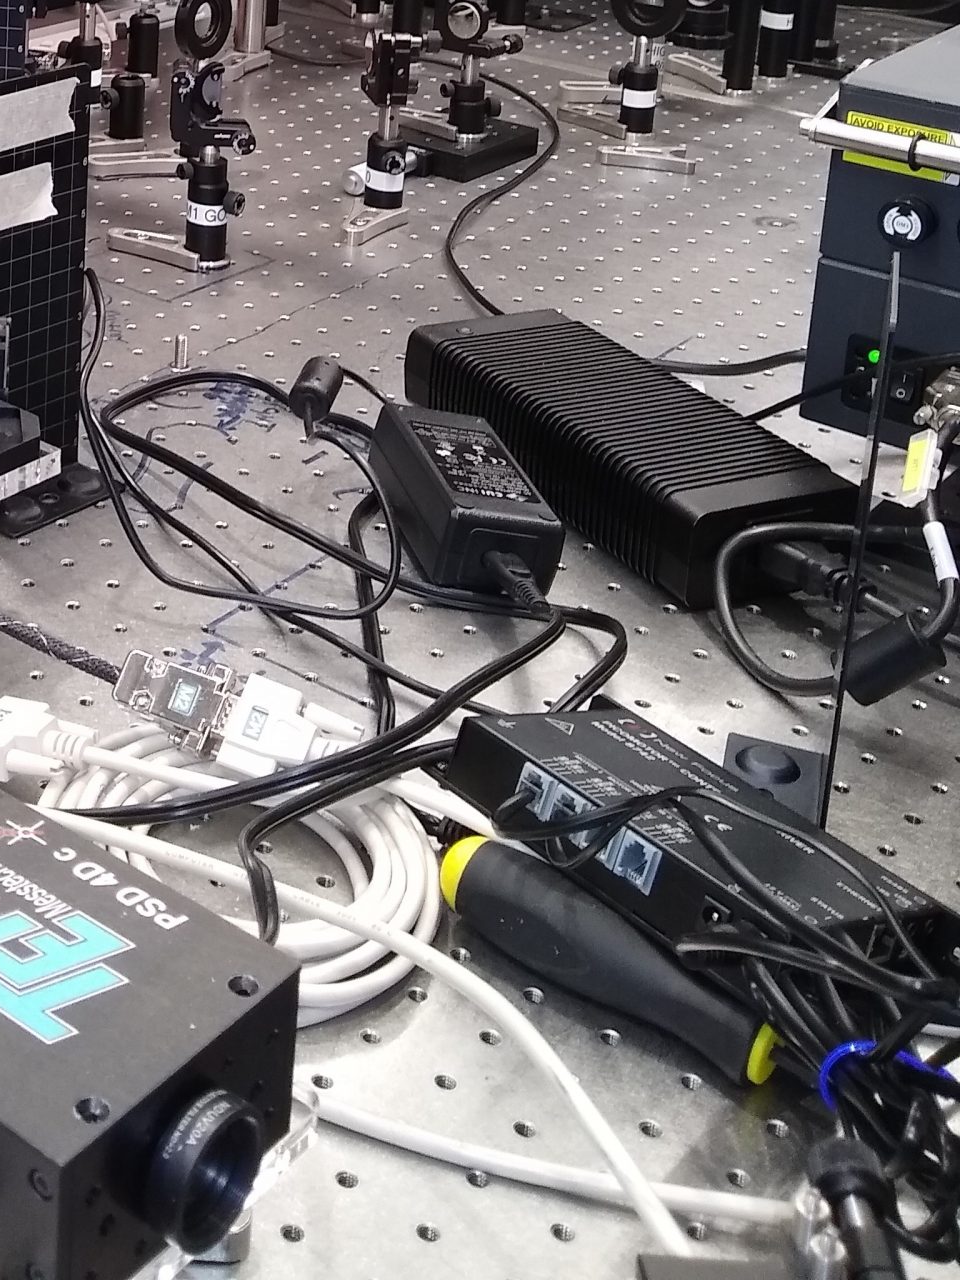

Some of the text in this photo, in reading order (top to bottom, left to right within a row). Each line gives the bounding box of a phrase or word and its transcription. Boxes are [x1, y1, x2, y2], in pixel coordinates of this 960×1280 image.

[853, 117, 884, 131] AVOID
[71, 861, 121, 888] 4D
[115, 886, 190, 930] PSD
